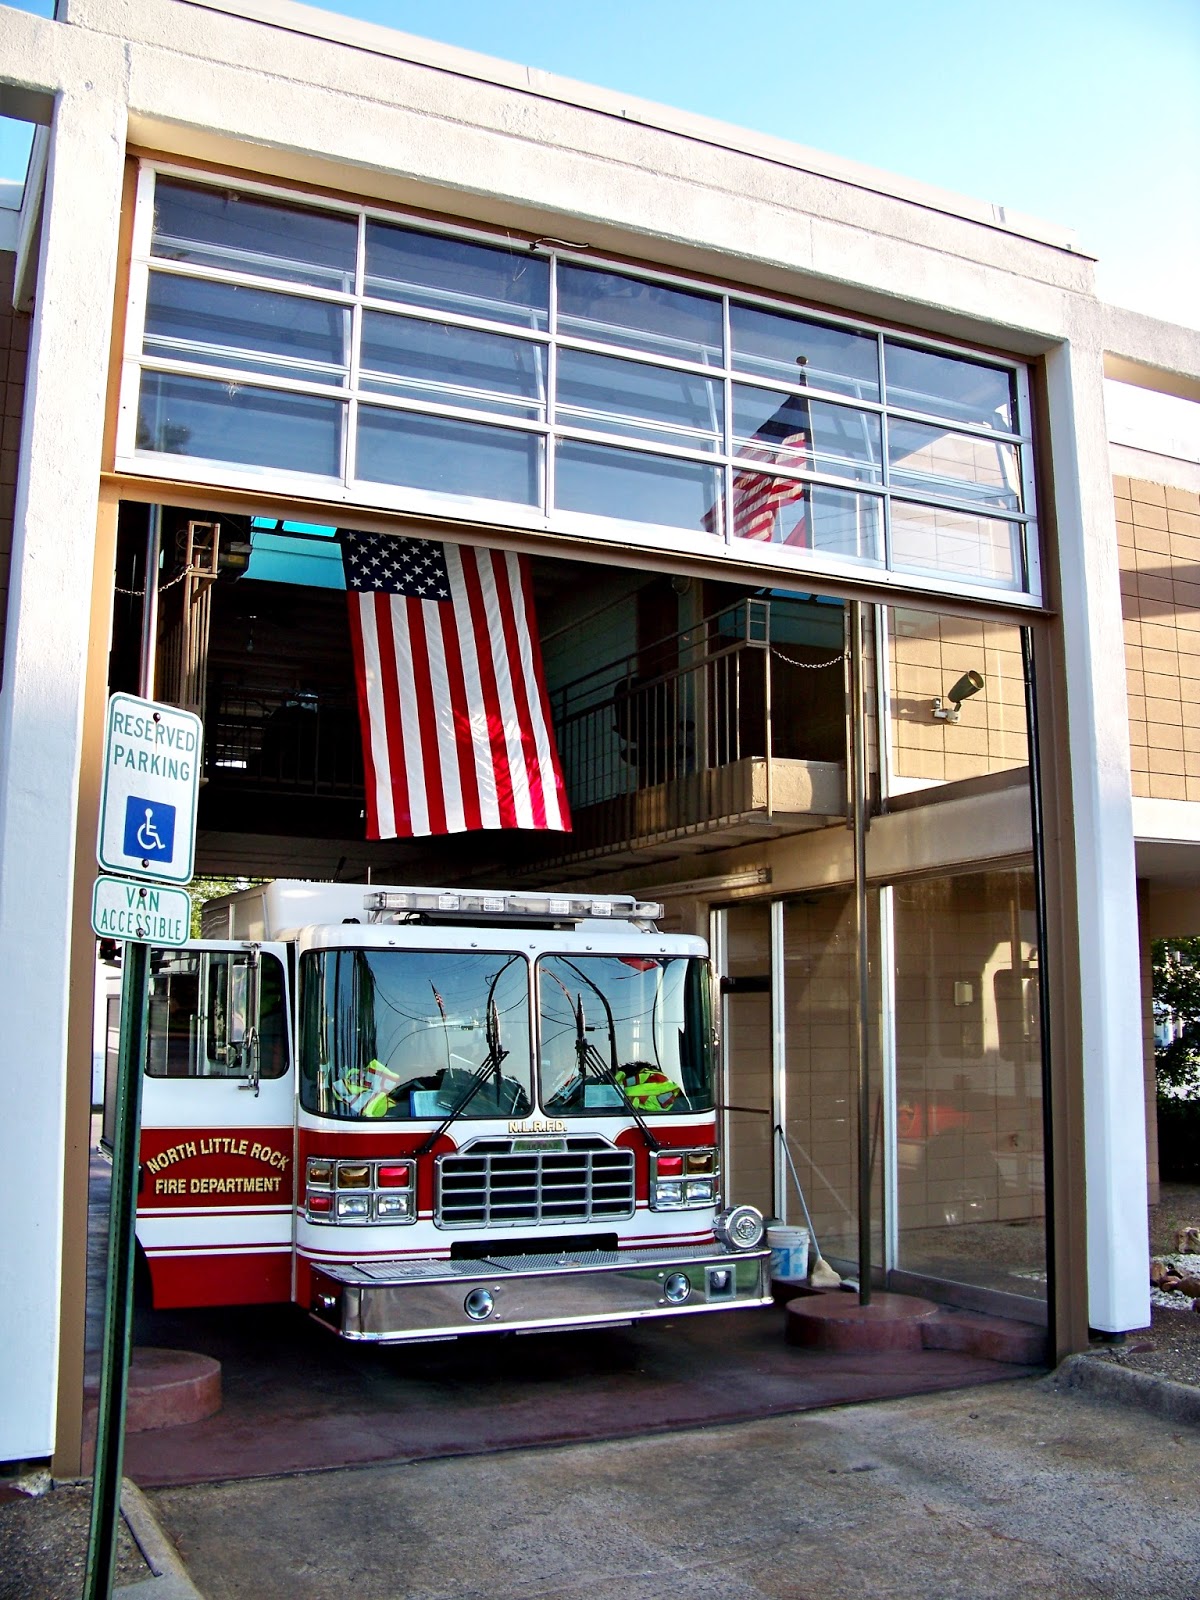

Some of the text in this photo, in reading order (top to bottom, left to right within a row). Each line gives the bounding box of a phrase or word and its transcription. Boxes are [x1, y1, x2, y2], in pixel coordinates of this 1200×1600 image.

[113, 711, 195, 752] RESERVED
[113, 744, 190, 782] PARKING
[126, 886, 160, 912] VAN
[100, 908, 182, 940] ACCESSIBLE
[146, 1137, 290, 1174] NORTH LITTLE ROCK
[155, 1177, 282, 1194] FIRE DEPARTMENT
